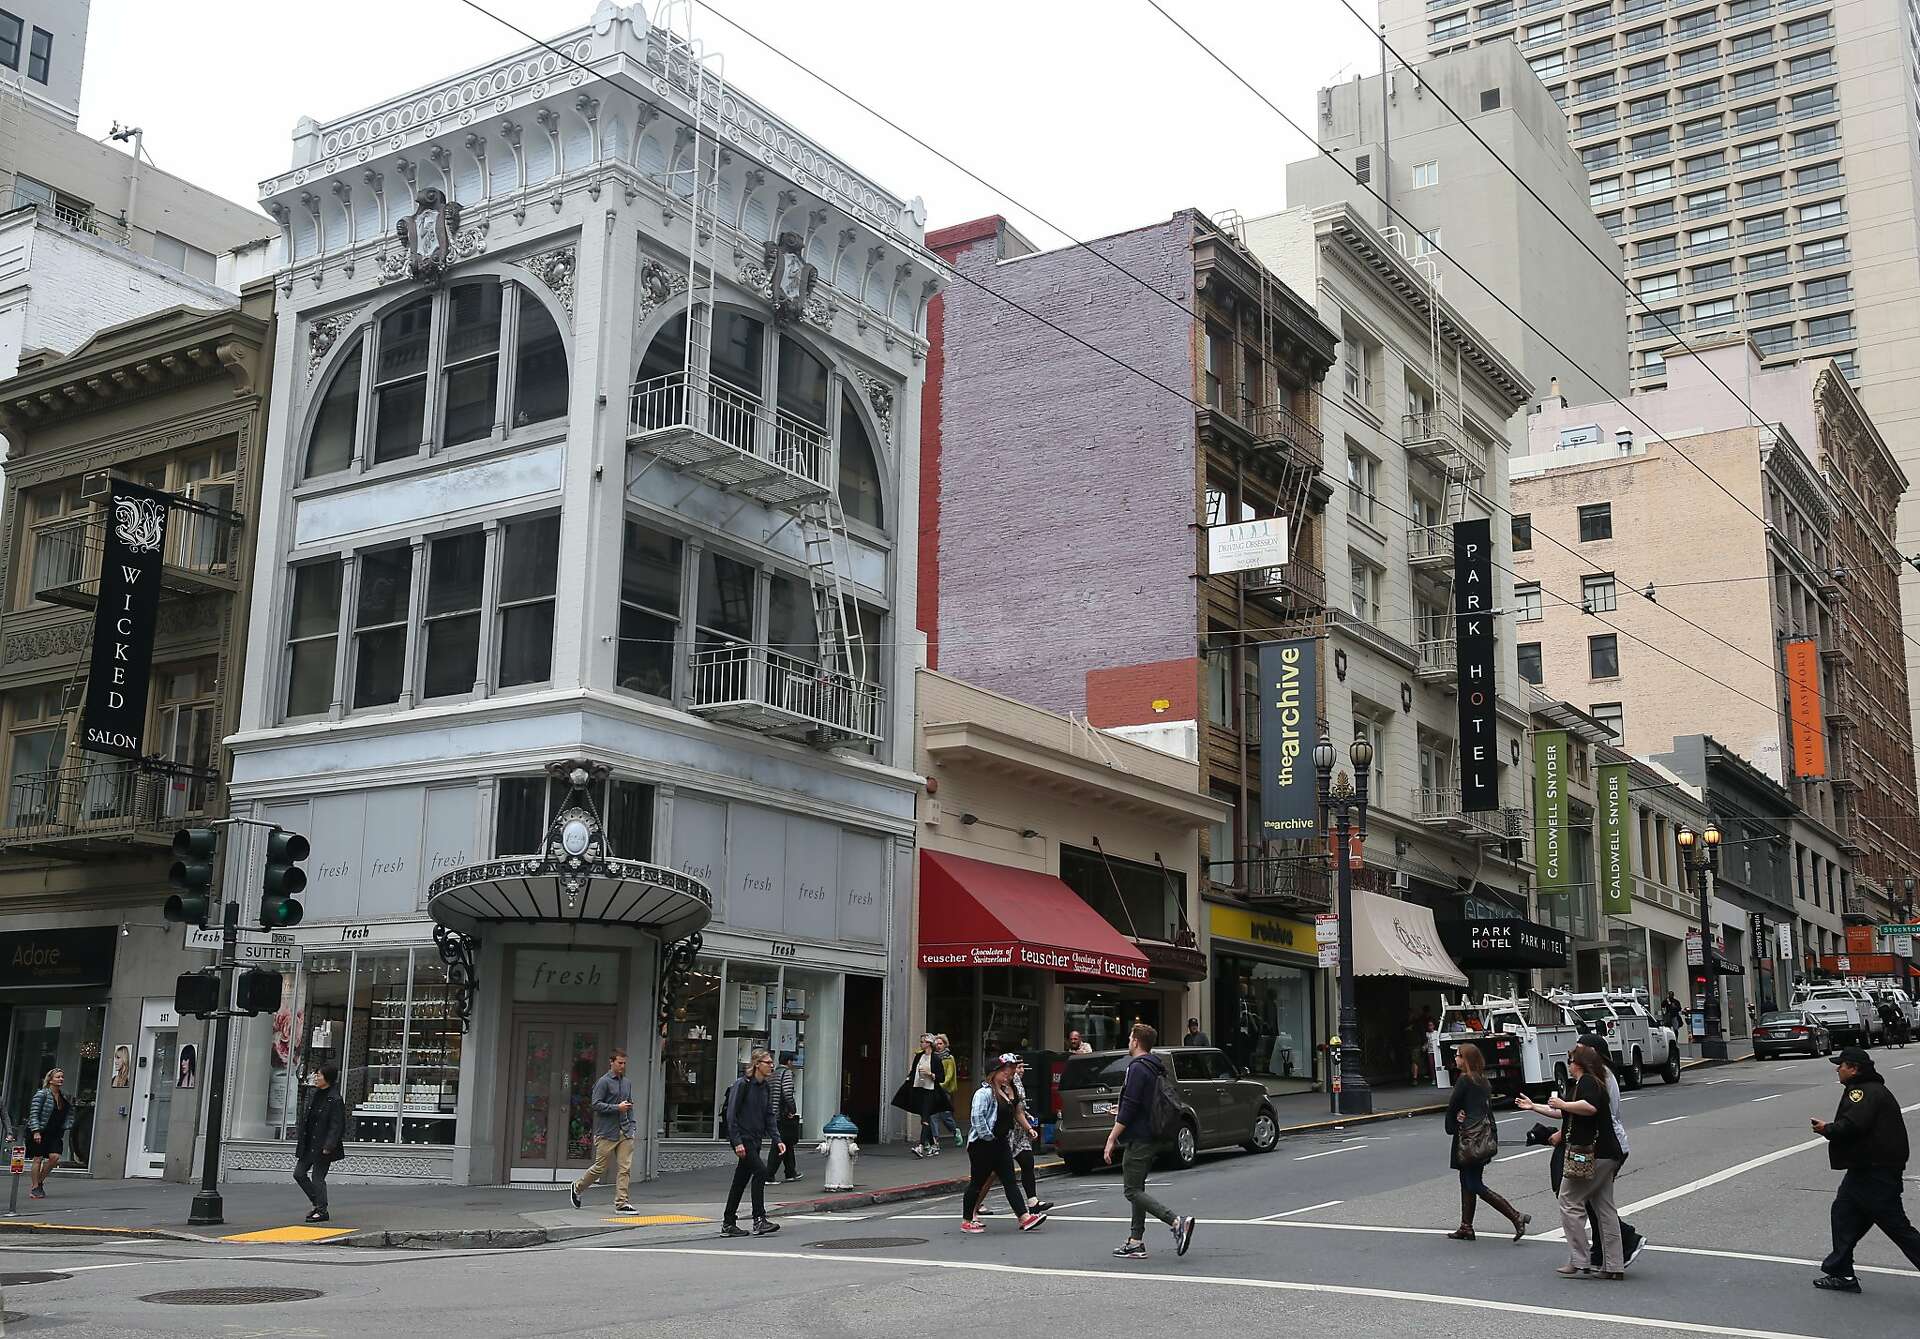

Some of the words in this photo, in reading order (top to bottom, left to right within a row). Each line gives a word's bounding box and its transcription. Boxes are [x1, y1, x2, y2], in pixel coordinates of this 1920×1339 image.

[1467, 544, 1481, 635] PARK
[108, 565, 142, 709] WICKED
[1471, 665, 1485, 788] HOTEL
[87, 728, 137, 750] SALON
[1546, 744, 1557, 799] SNYDER
[1609, 776, 1618, 826] SNYDER
[1546, 804, 1559, 879] CALDWELL
[371, 857, 404, 878] fresh
[431, 850, 465, 870] fresh
[682, 860, 712, 879] fresh
[1610, 829, 1620, 900] CALDWELL
[317, 862, 349, 881] fresh
[742, 873, 772, 892] fresh
[799, 883, 825, 901] fresh
[848, 889, 873, 906] fresh
[192, 929, 220, 943] fresh
[341, 926, 370, 941] fresh
[1472, 926, 1512, 936] PARK
[771, 941, 796, 957] fresh
[971, 947, 1003, 957] Chocolates
[1005, 946, 1014, 958] of
[1472, 939, 1512, 948] HOTEL
[1520, 932, 1538, 948] PARK
[1541, 938, 1563, 954] HOTEL
[12, 942, 61, 968] Adore
[246, 947, 291, 959] SUTTER
[923, 953, 967, 964] teuscher
[973, 955, 1011, 964] Switzerland
[1020, 947, 1069, 967] teuscher
[1072, 952, 1096, 965] Chocolates
[1096, 957, 1103, 968] of
[532, 962, 601, 990] fresh
[1073, 964, 1101, 975] Switzerland
[1104, 959, 1148, 978] teuscher
